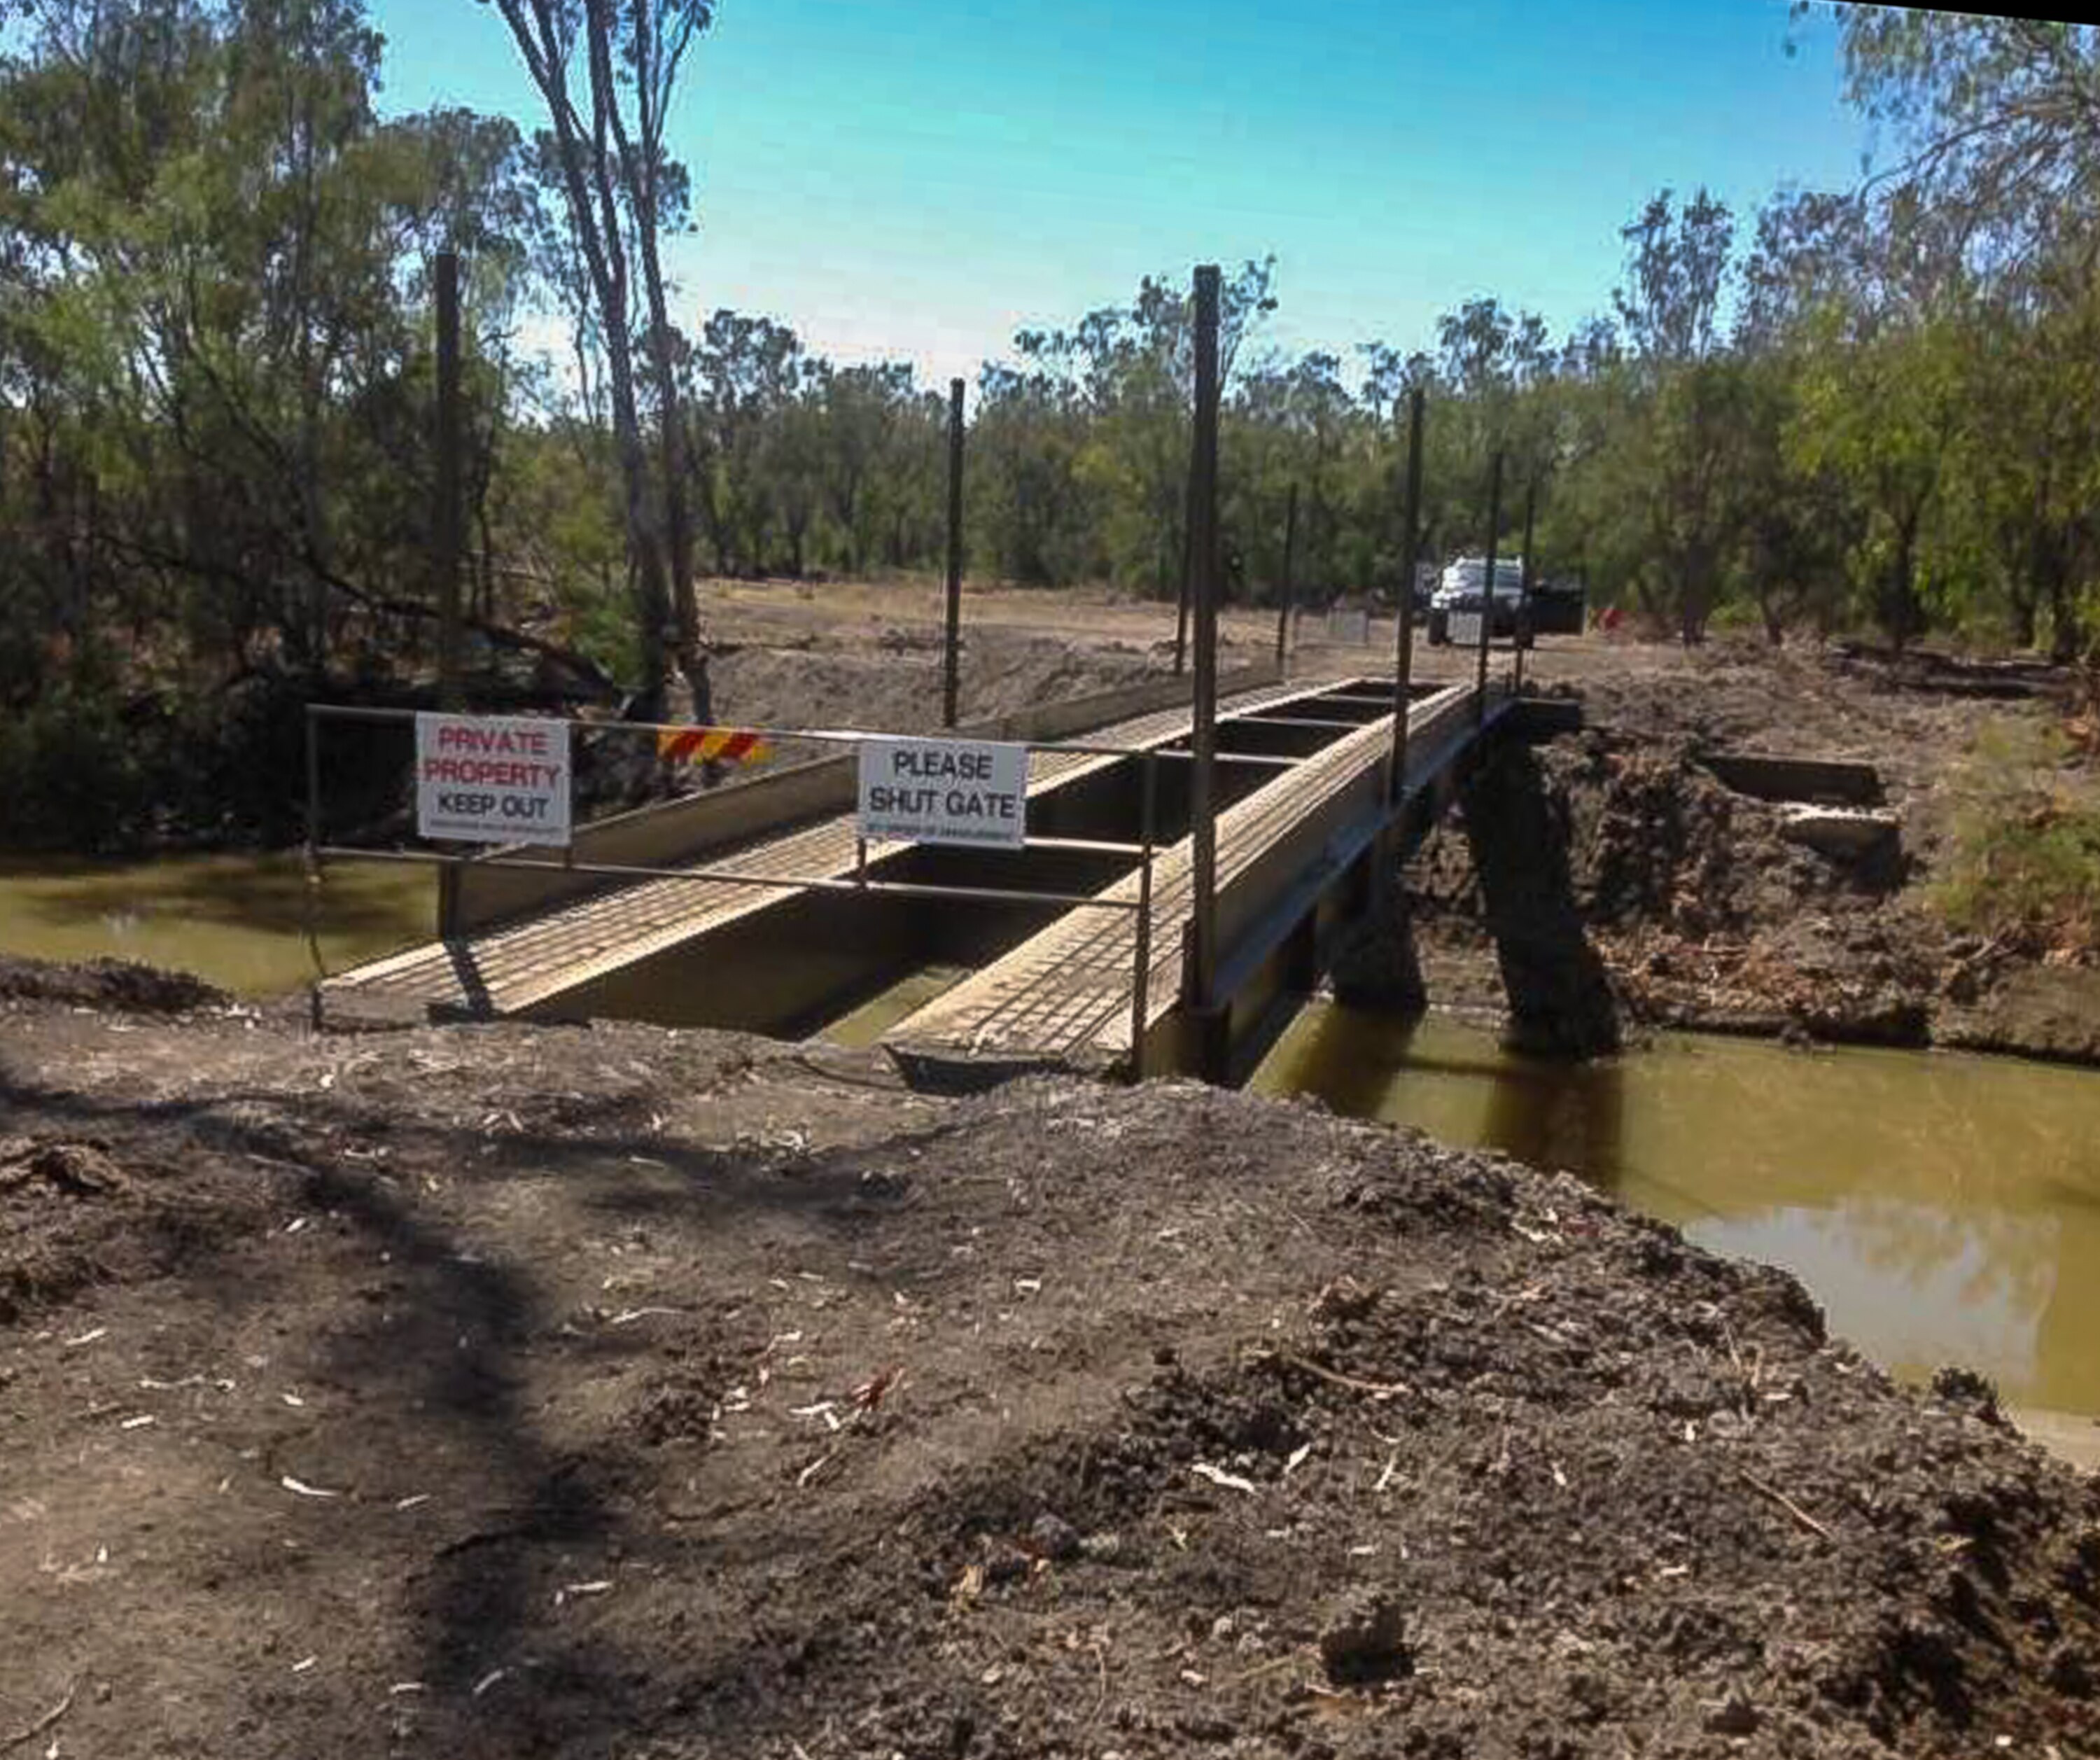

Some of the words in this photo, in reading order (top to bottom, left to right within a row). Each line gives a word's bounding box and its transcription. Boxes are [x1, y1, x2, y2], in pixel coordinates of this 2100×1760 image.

[438, 725, 549, 755] PRIVATE
[422, 757, 561, 789] PROPERTY
[893, 750, 994, 781] PLEASE
[437, 792, 497, 817] KEEP
[501, 795, 550, 819] OUT
[869, 786, 939, 814] SHUT
[946, 790, 1017, 819] GATE
